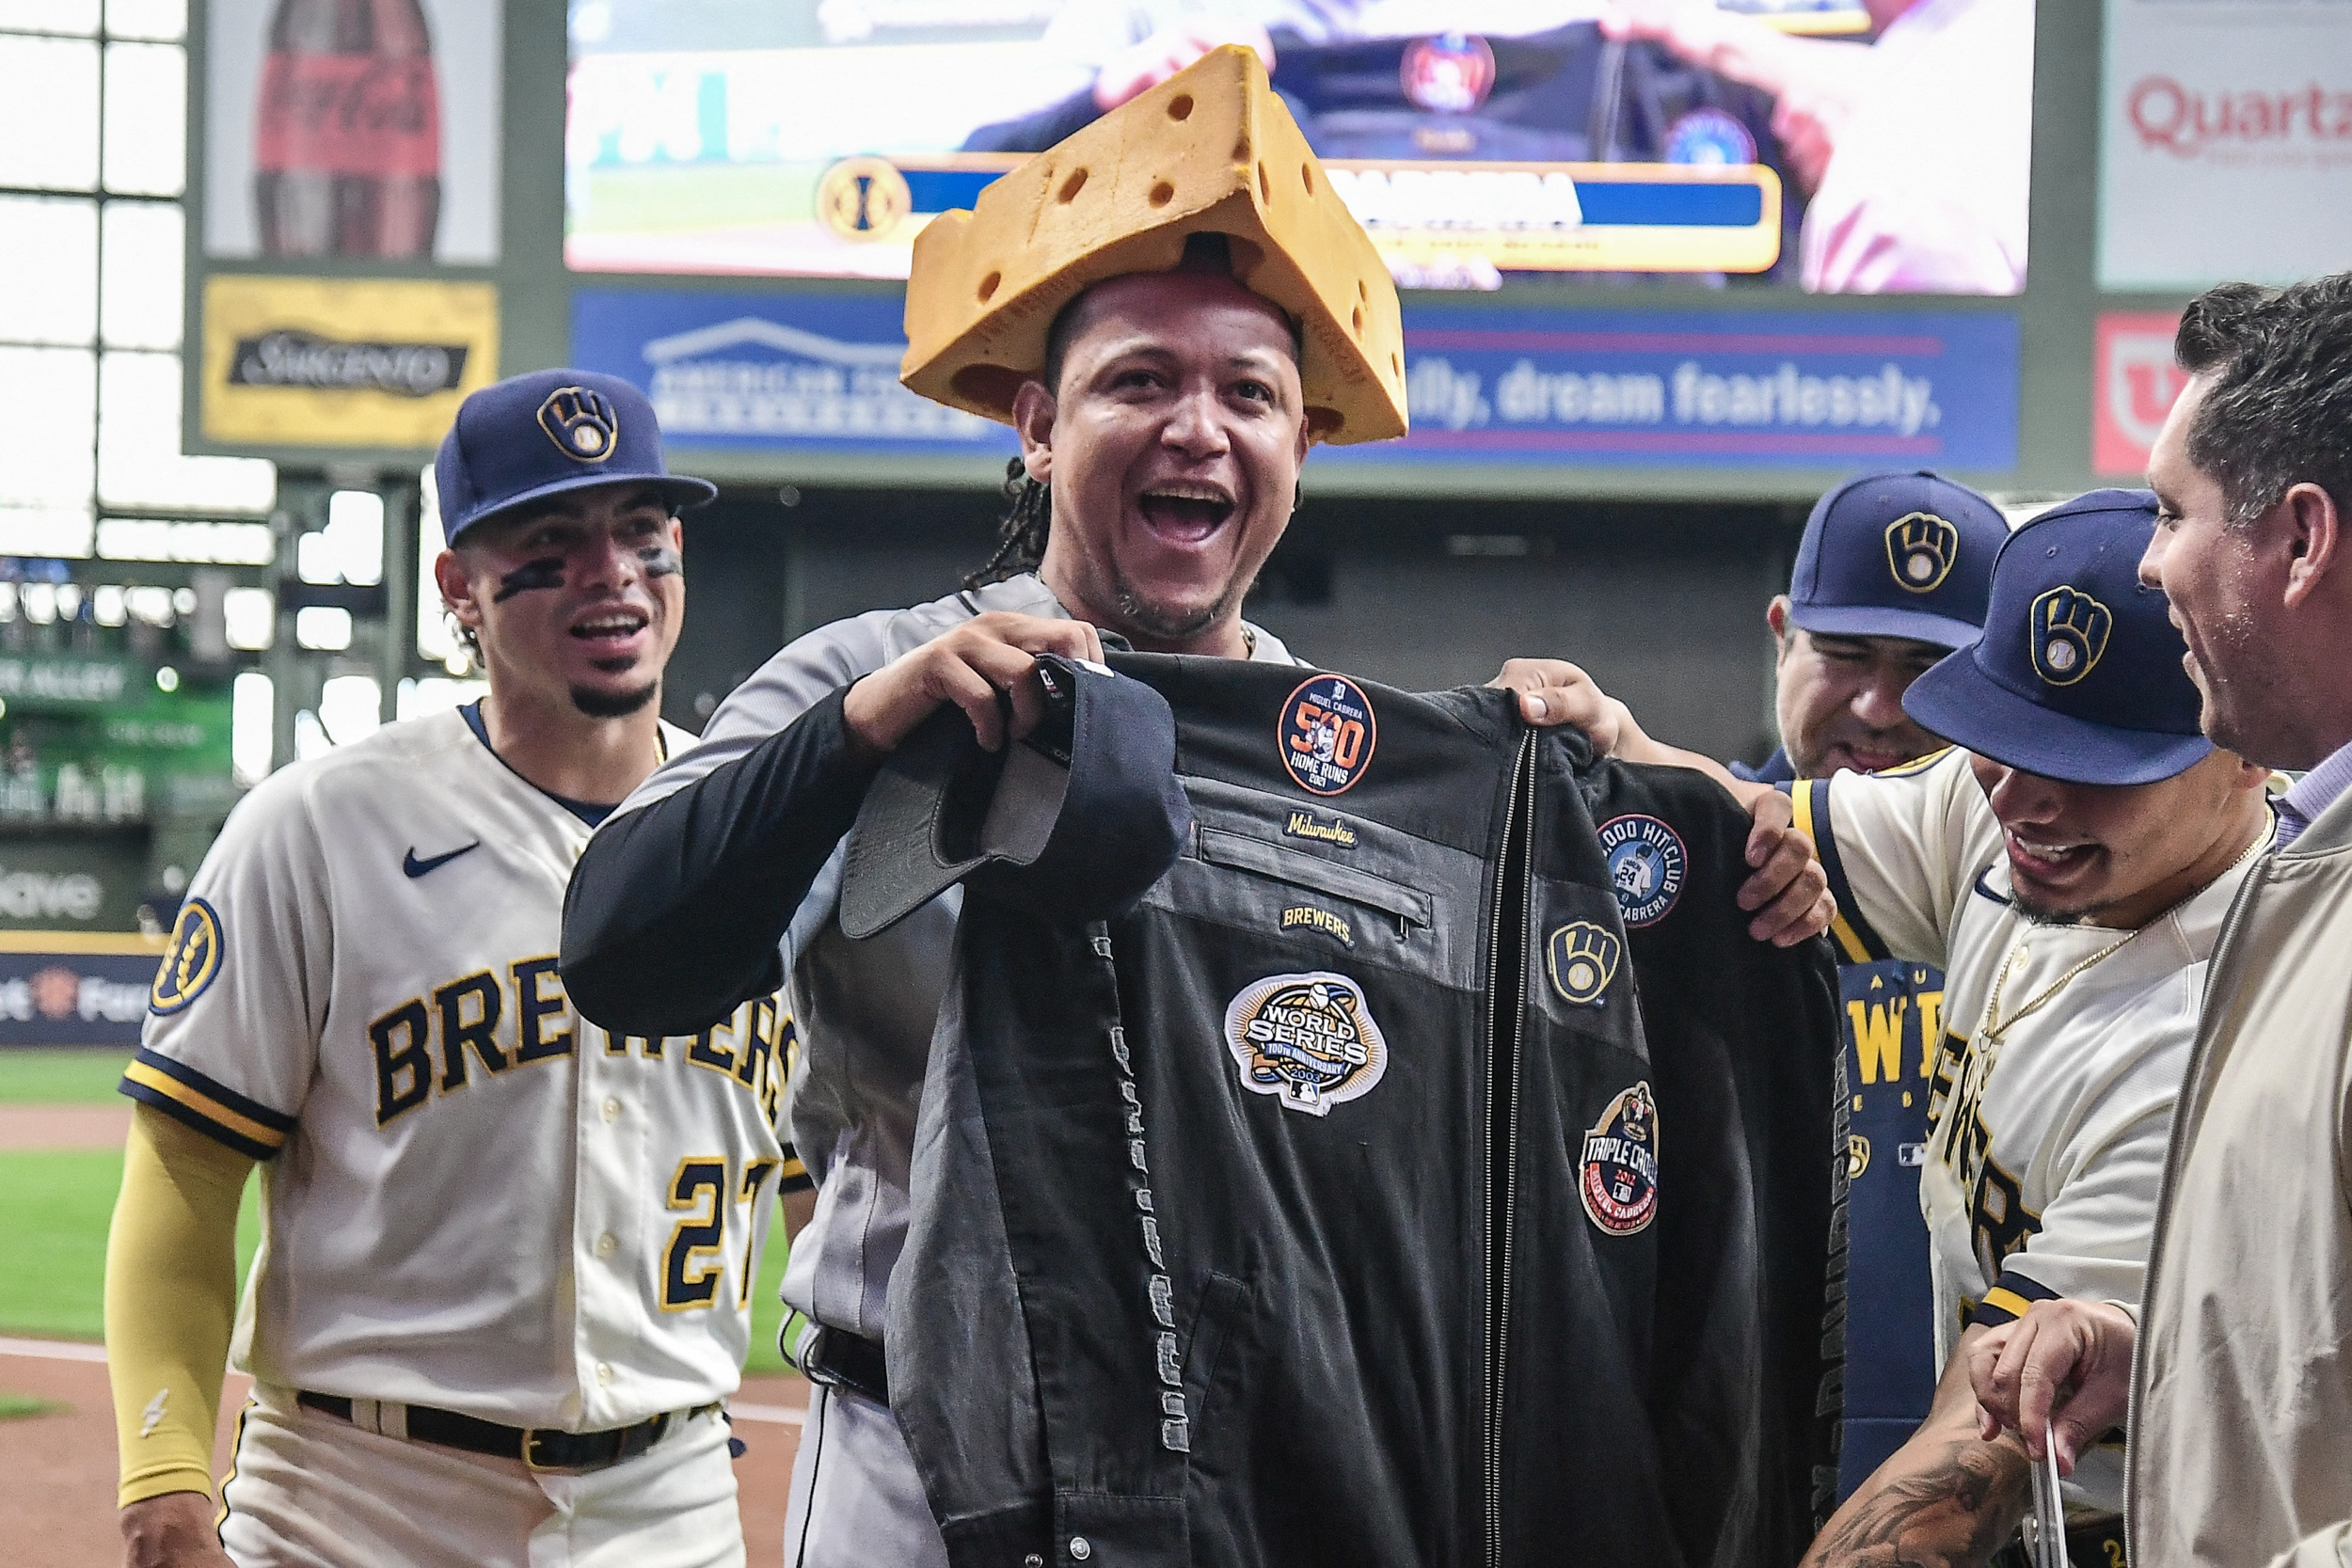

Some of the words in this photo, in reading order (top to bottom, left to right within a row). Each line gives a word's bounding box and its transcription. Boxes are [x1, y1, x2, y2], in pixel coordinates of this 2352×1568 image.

[1496, 357, 1665, 424] dream
[1674, 359, 1943, 436] fearlessly.
[1309, 692, 1331, 709] MIGUEL
[1332, 701, 1363, 721] CABRERA
[1290, 751, 1319, 775] HOME
[1320, 763, 1349, 785] RUNS
[1308, 773, 1327, 788] 2021
[1287, 812, 1356, 844] Milwaukee
[1602, 820, 1637, 858] ,000
[1642, 821, 1671, 848] HIT
[1662, 845, 1682, 894] CLUB
[1619, 866, 1637, 887] 24
[0, 870, 102, 920] ave
[1283, 906, 1350, 942] BREWERS
[1265, 1005, 1356, 1041] WORLD
[1246, 1019, 1369, 1066] SERIES
[1291, 1069, 1321, 1083] 2003
[1292, 1048, 1343, 1075] ANNIVERSARY
[1586, 1136, 1631, 1165] TRIPLE
[1592, 1169, 1613, 1214] MIGUEL
[1613, 1192, 1654, 1219] CABRERA
[1614, 1168, 1637, 1187] 2012
